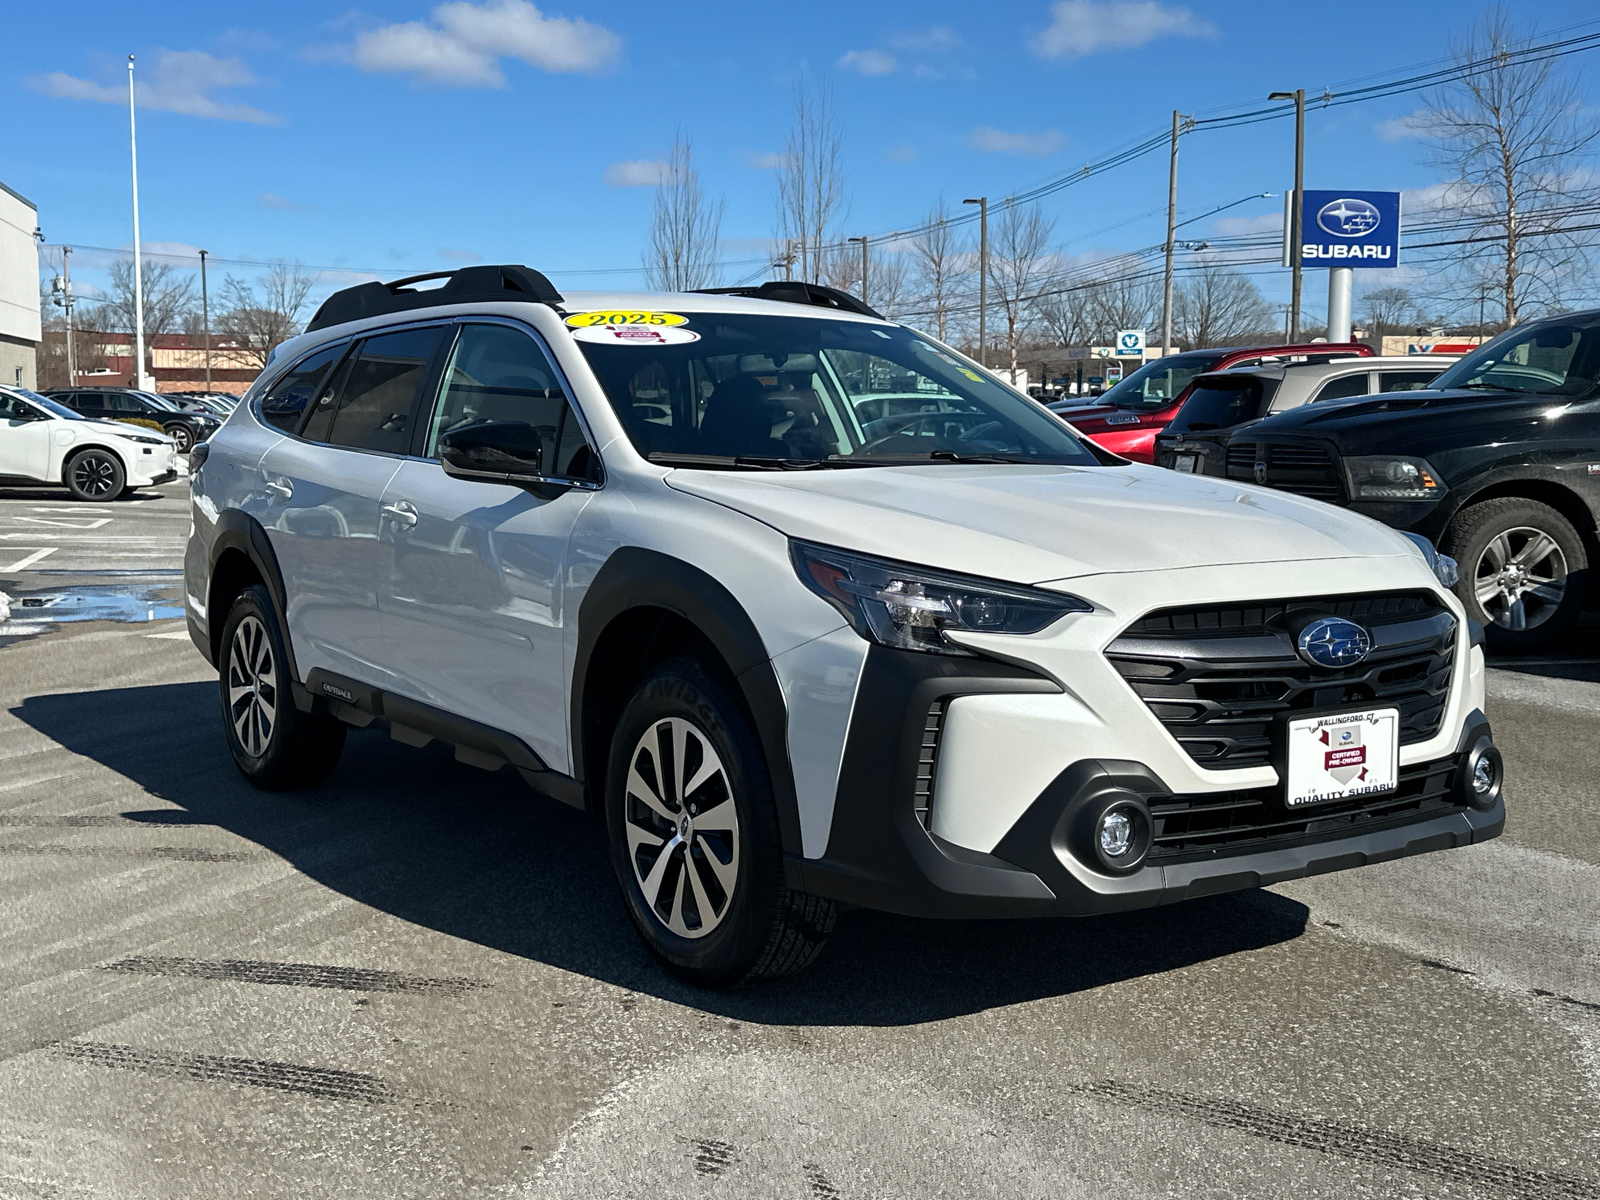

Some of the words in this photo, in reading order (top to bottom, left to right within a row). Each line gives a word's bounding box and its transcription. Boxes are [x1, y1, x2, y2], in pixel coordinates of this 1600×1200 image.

[1302, 244, 1391, 259] SUBARU
[589, 313, 667, 327] 2025
[323, 683, 352, 700] OUTBACK
[1329, 756, 1363, 766] PRE-OWNED
[1332, 750, 1360, 759] CERTIFIED
[1294, 790, 1345, 805] QUALITY
[1348, 782, 1394, 797] SUBARU
